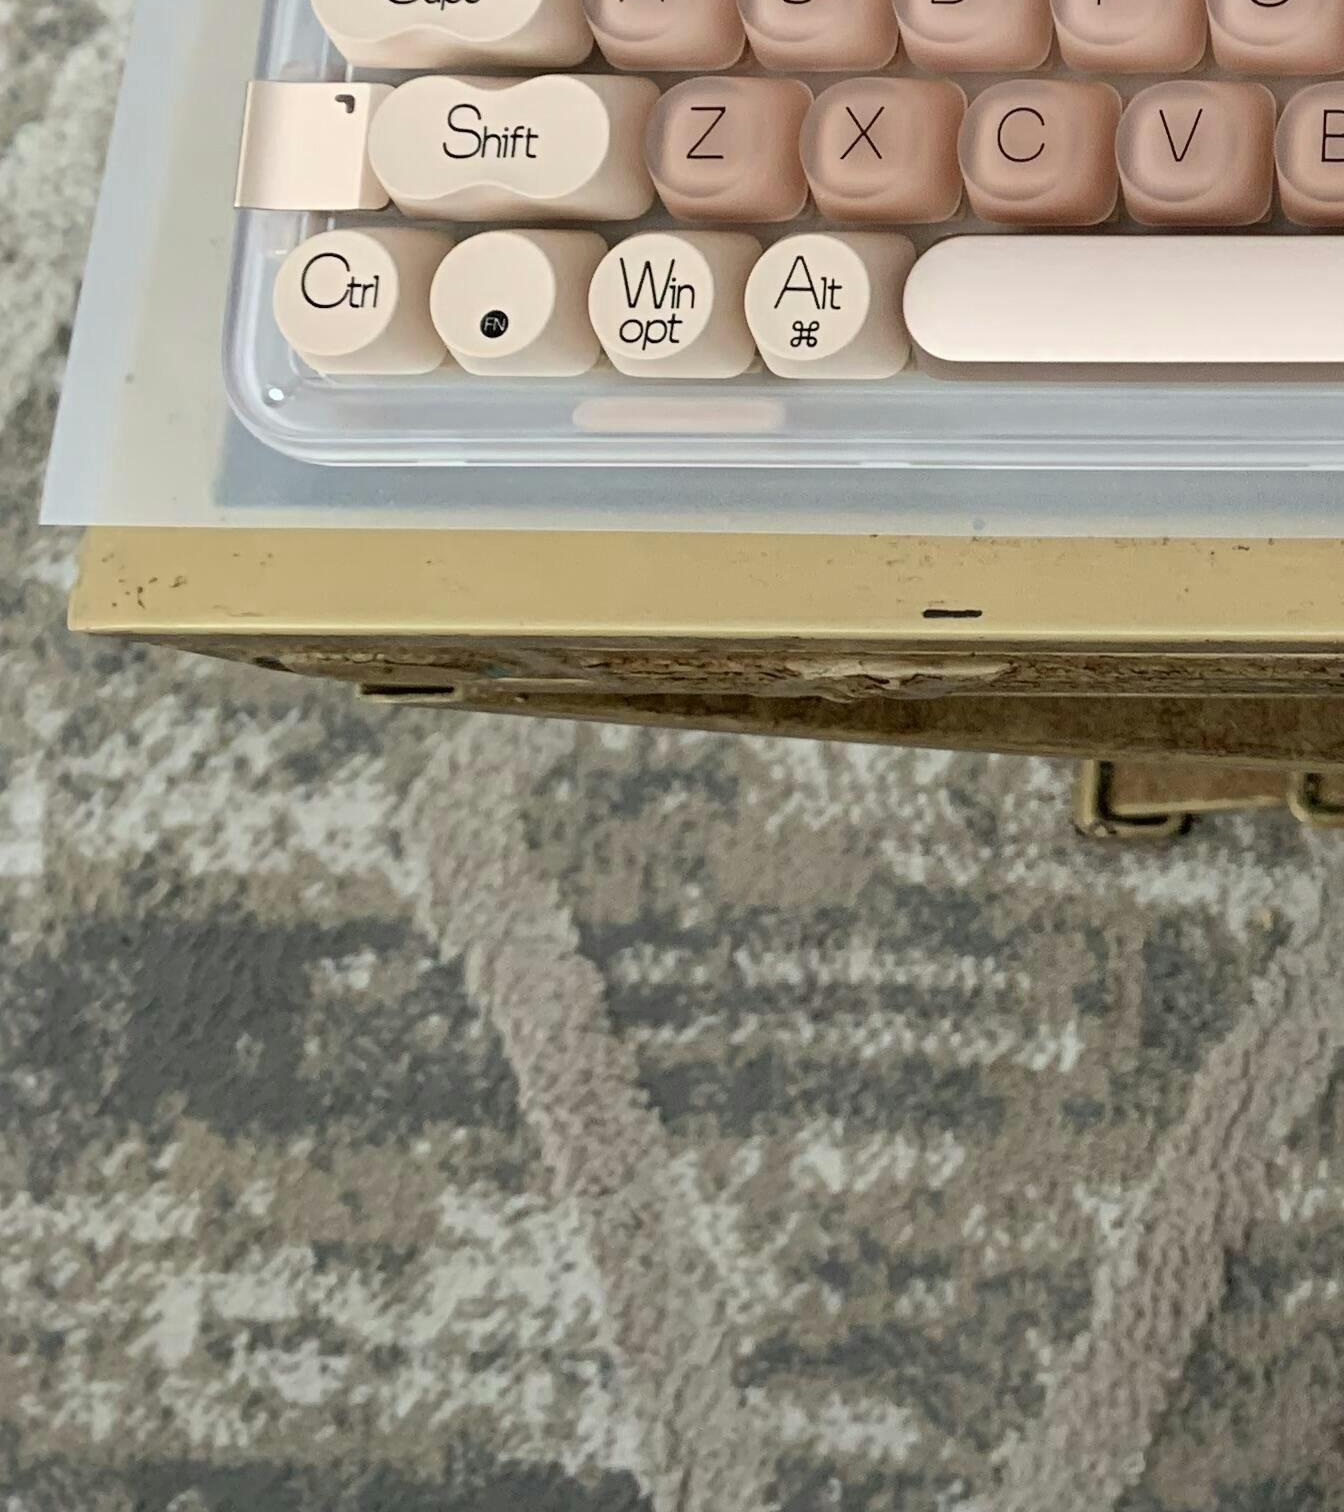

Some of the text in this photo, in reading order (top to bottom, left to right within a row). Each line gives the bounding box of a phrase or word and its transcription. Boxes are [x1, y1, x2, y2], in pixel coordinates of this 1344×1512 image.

[442, 103, 539, 160] Shift
[686, 106, 727, 160] Z
[839, 106, 885, 160] X
[997, 106, 1046, 163] C
[1158, 108, 1203, 163] V
[300, 252, 380, 309] Ctrl
[619, 257, 696, 310] Win
[773, 255, 843, 311] Alt
[483, 317, 507, 333] FN
[618, 313, 684, 351] opt
